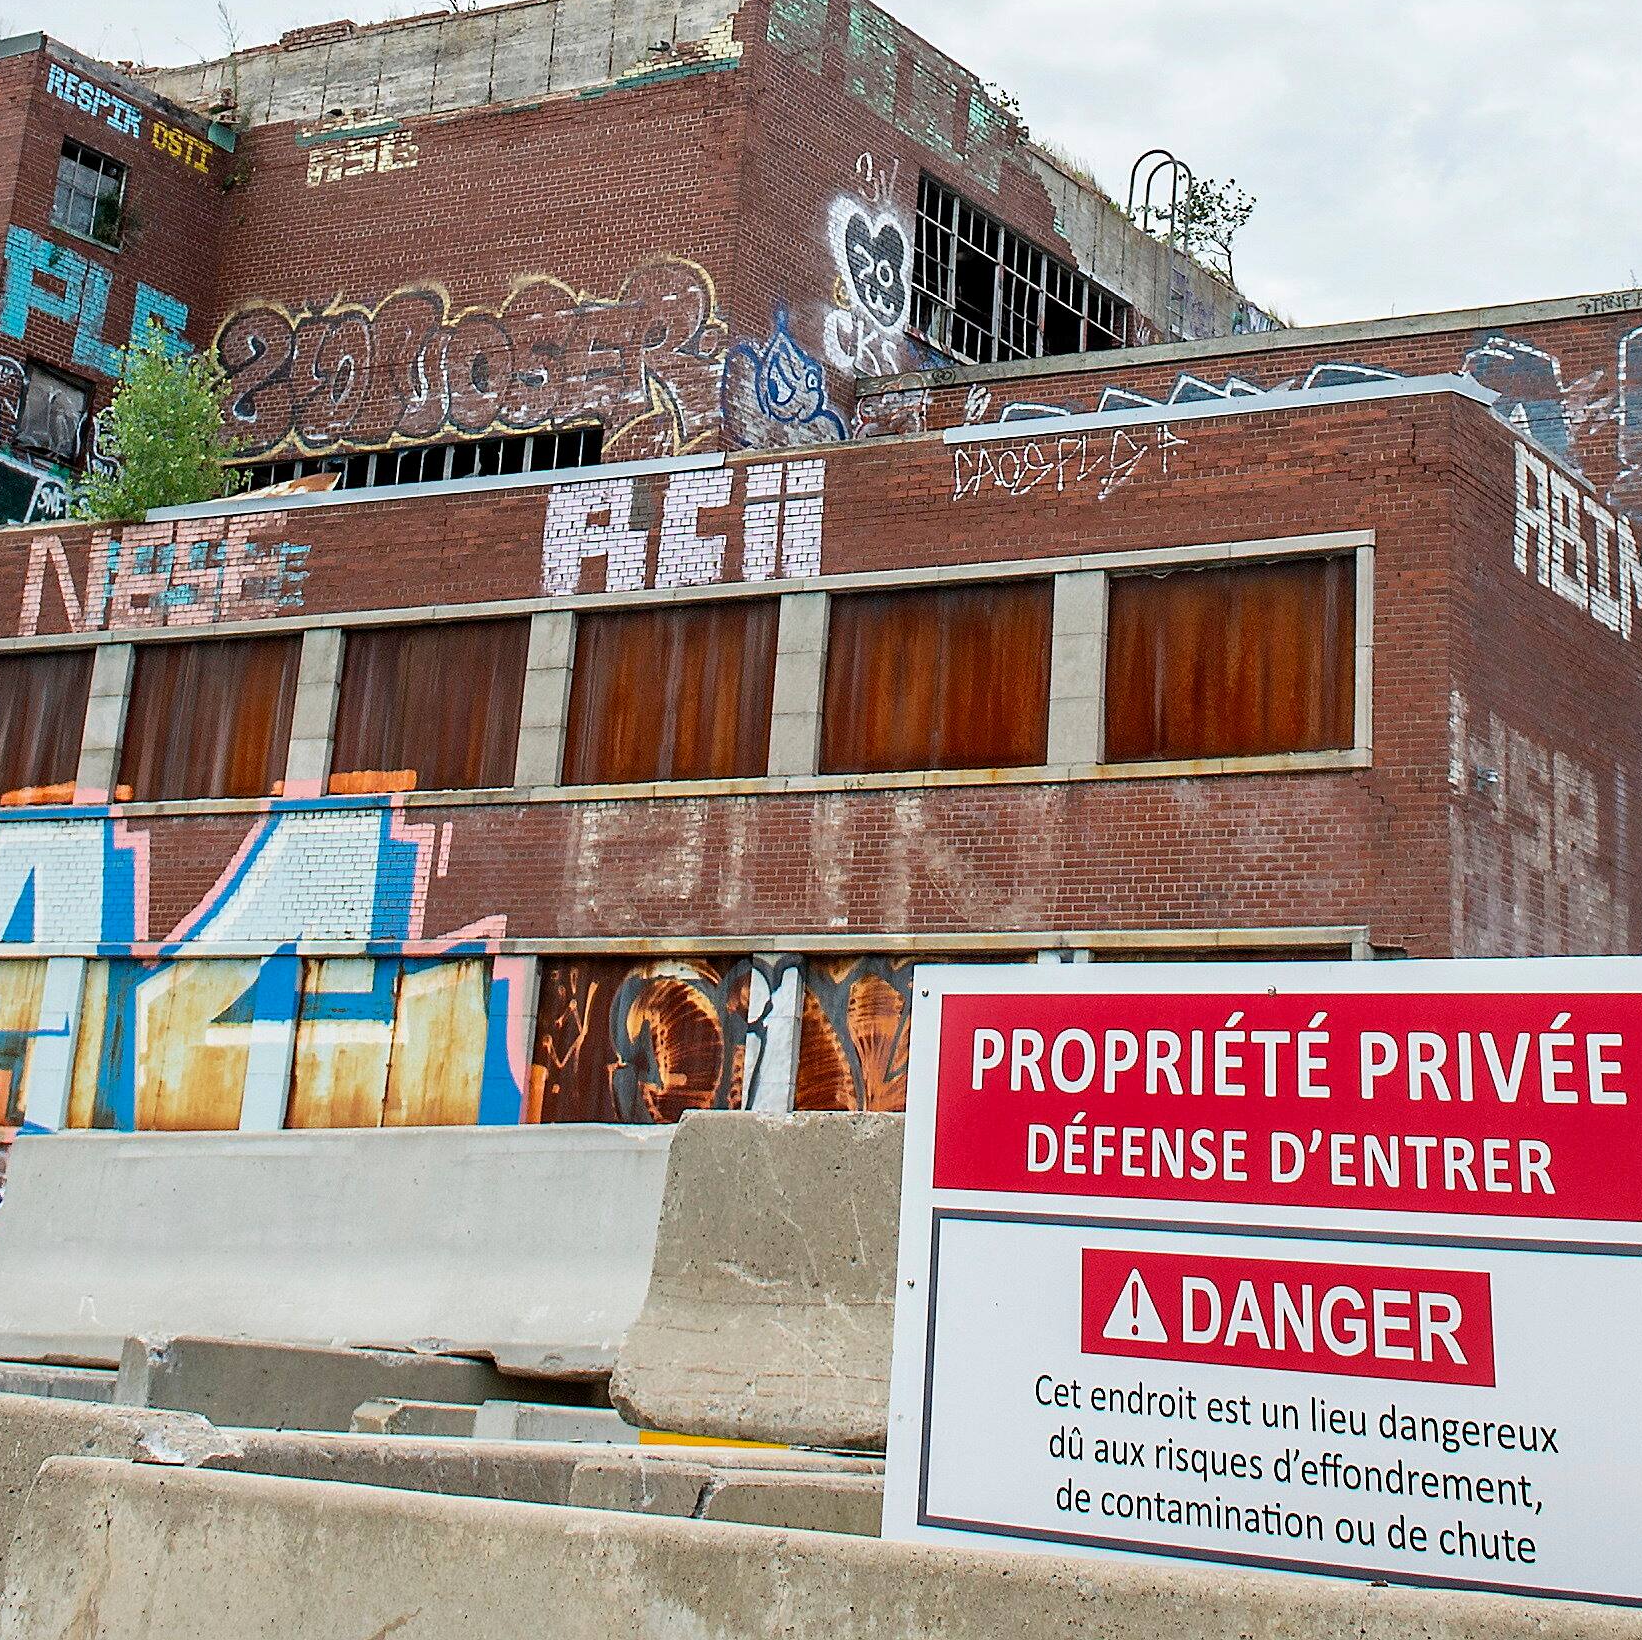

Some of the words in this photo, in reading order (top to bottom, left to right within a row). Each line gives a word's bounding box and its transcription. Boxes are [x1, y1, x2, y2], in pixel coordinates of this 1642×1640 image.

[972, 1012, 1330, 1098] PROPRIÉTÉ
[1361, 1013, 1627, 1105] PRIVÉE
[1028, 1112, 1247, 1181] DÉFENSE
[1182, 1277, 1469, 1365] DANGER
[1036, 1375, 1081, 1409] Cet
[1091, 1381, 1196, 1420] endroit
[1208, 1396, 1251, 1425] est
[1262, 1403, 1299, 1430] un
[1311, 1397, 1367, 1436] lieu
[1380, 1404, 1558, 1453] dangereux
[1050, 1426, 1083, 1460] dû
[1095, 1440, 1144, 1467] aux
[1156, 1438, 1262, 1482] risques
[1057, 1478, 1090, 1512] de
[1102, 1493, 1323, 1541] contamination
[1336, 1519, 1374, 1546] ou
[1387, 1515, 1426, 1551] de
[1440, 1521, 1535, 1563] chute
